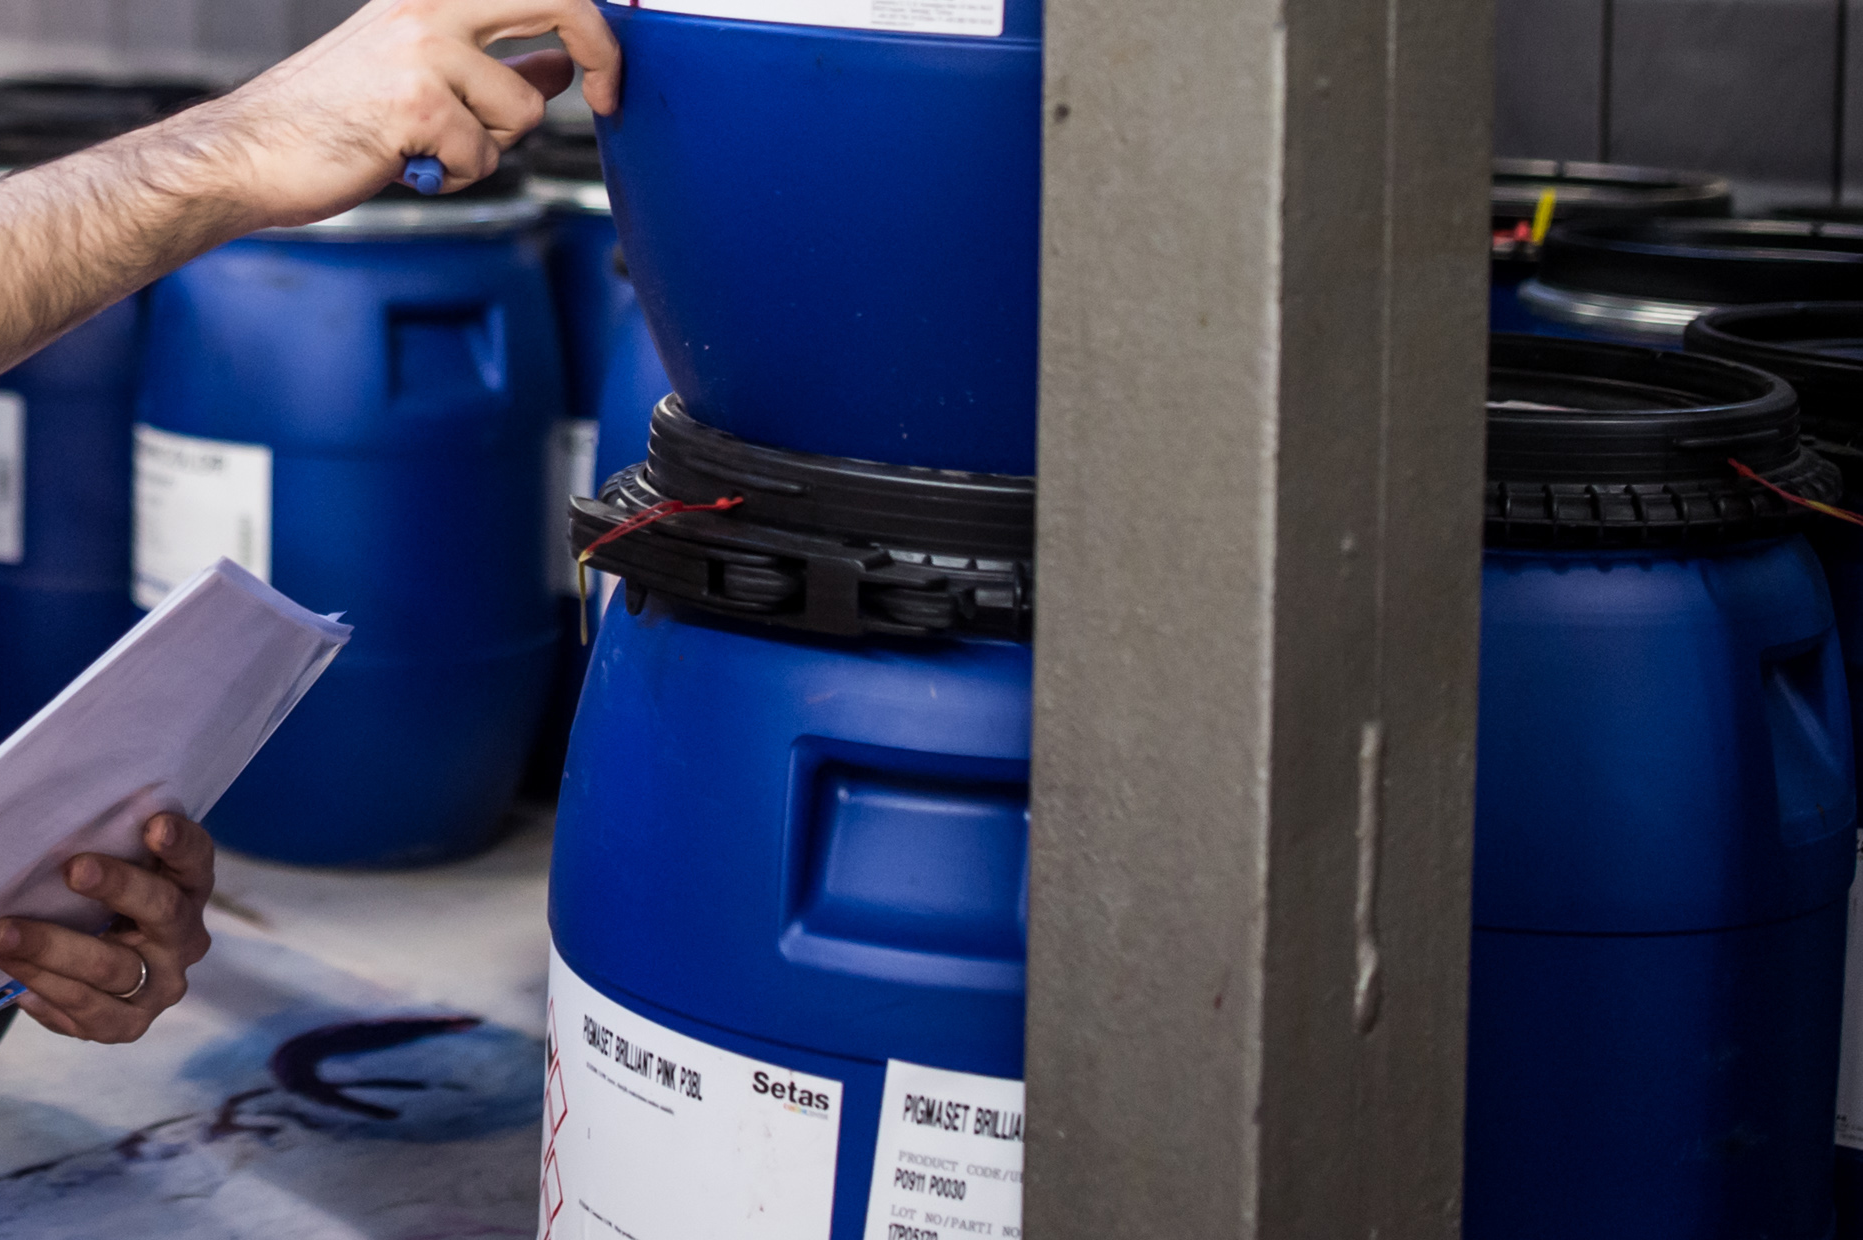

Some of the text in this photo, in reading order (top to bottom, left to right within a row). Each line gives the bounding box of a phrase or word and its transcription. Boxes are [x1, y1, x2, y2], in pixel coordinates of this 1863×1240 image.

[583, 1014, 613, 1058] PIGMASET
[615, 1035, 655, 1079] BRILLIANT
[656, 1056, 678, 1091] PINK
[680, 1066, 703, 1101] P3BL
[752, 1071, 829, 1111] Setas
[903, 1093, 970, 1133] PIGMASET
[898, 1150, 959, 1173] PRODUCT
[894, 1167, 967, 1201] P0911 P0030
[891, 1204, 917, 1221] LOT
[925, 1212, 993, 1236] NO/PARTI
